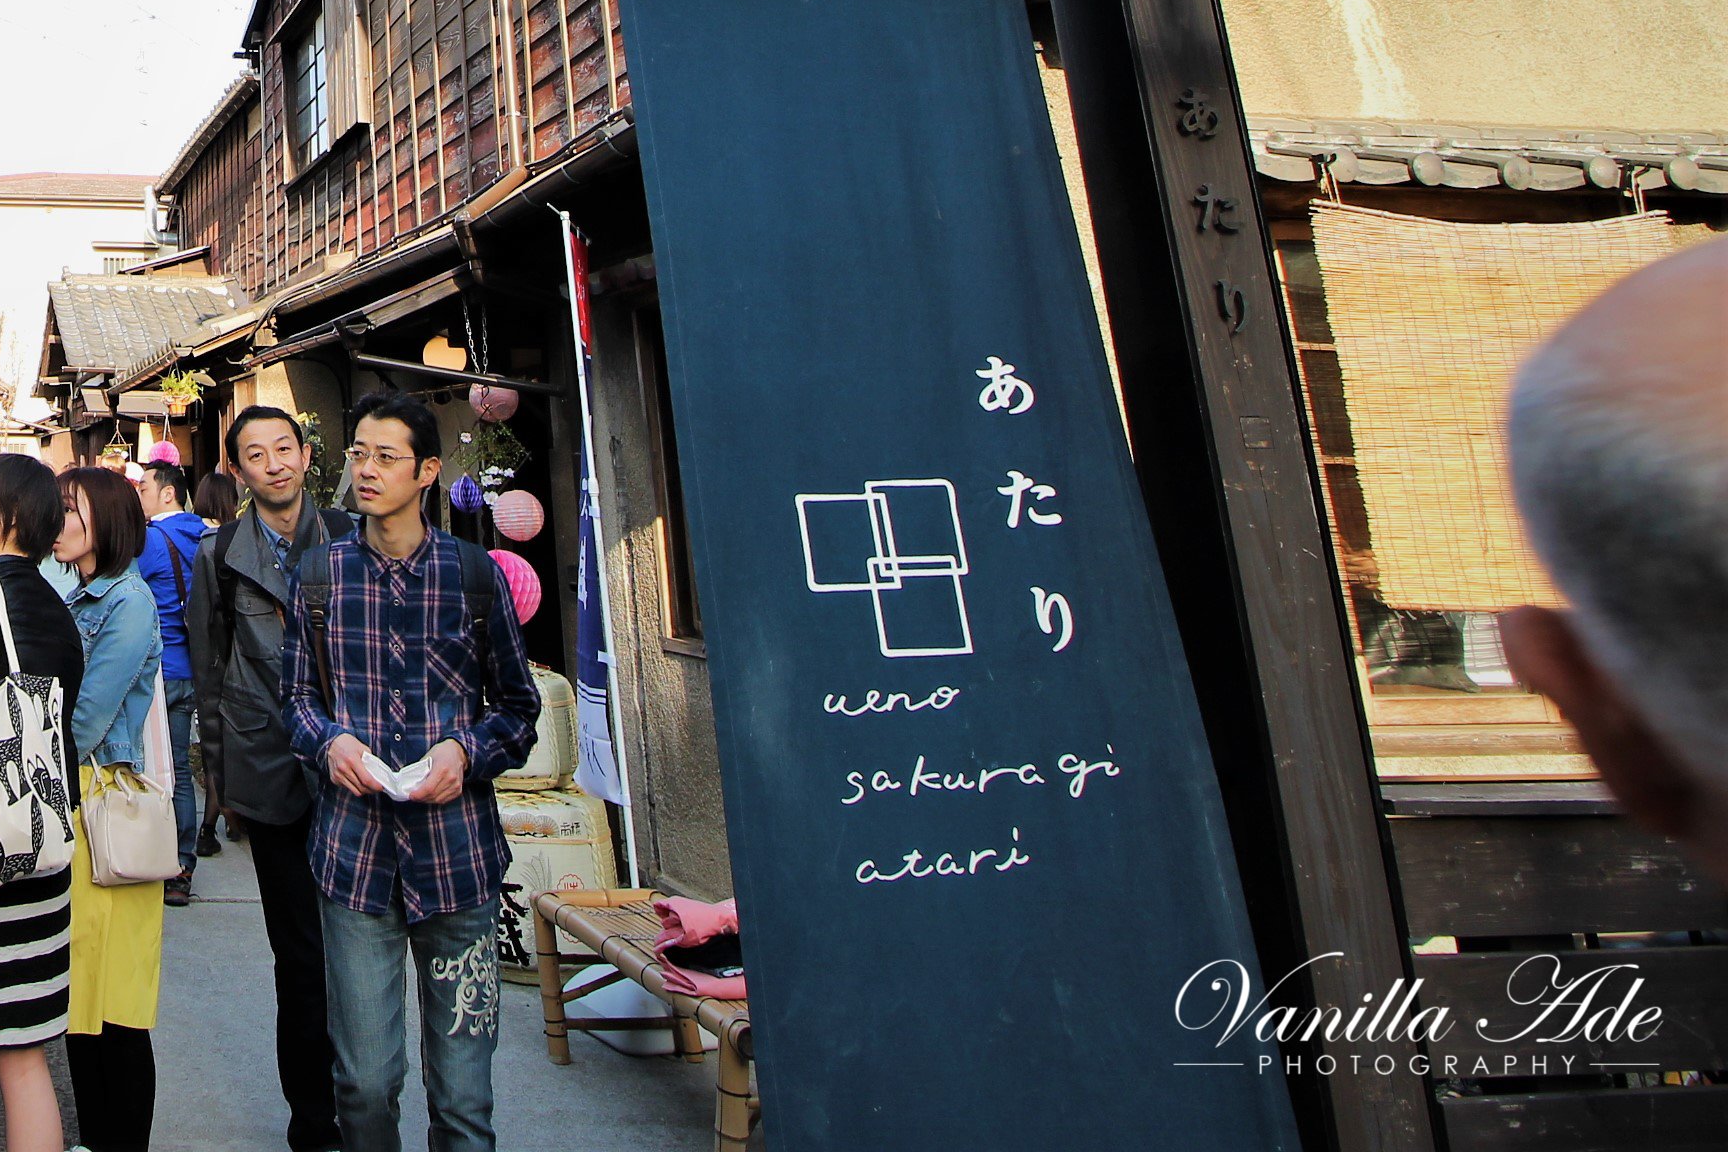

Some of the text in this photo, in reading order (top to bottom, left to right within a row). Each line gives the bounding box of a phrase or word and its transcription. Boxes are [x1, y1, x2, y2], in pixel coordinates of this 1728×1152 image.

[1175, 87, 1250, 334] あたり
[975, 355, 1074, 654] あたり
[823, 685, 961, 715] ueno
[855, 826, 1030, 885] atari
